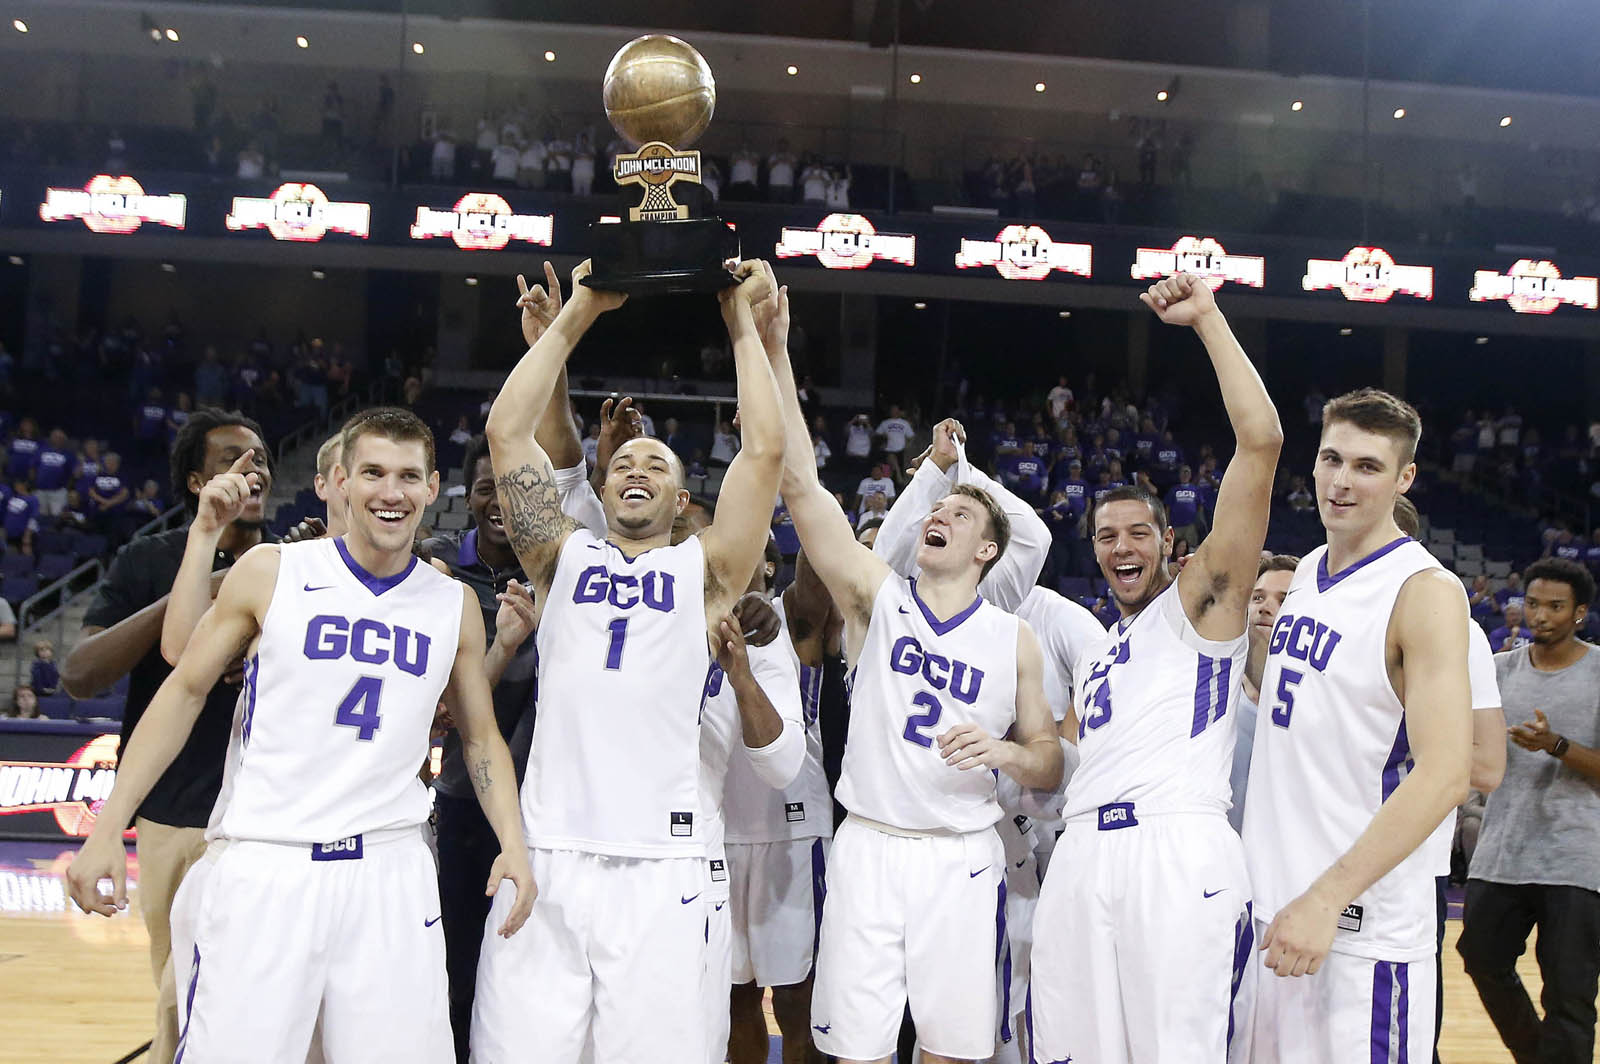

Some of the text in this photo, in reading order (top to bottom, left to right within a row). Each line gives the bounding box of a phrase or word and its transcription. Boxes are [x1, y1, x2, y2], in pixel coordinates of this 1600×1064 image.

[617, 156, 696, 177] JOHN MCLENDON
[640, 211, 677, 220] CHAMPION
[572, 565, 675, 613] GCU
[303, 615, 431, 677] GCU
[603, 617, 629, 671] 1
[890, 636, 985, 705] GCU
[1269, 615, 1342, 672] GCU
[333, 674, 384, 742] 4
[902, 689, 943, 750] 2
[1271, 665, 1305, 730] 5
[679, 814, 686, 822] L
[1103, 808, 1127, 824] GCU
[321, 837, 357, 854] GCU
